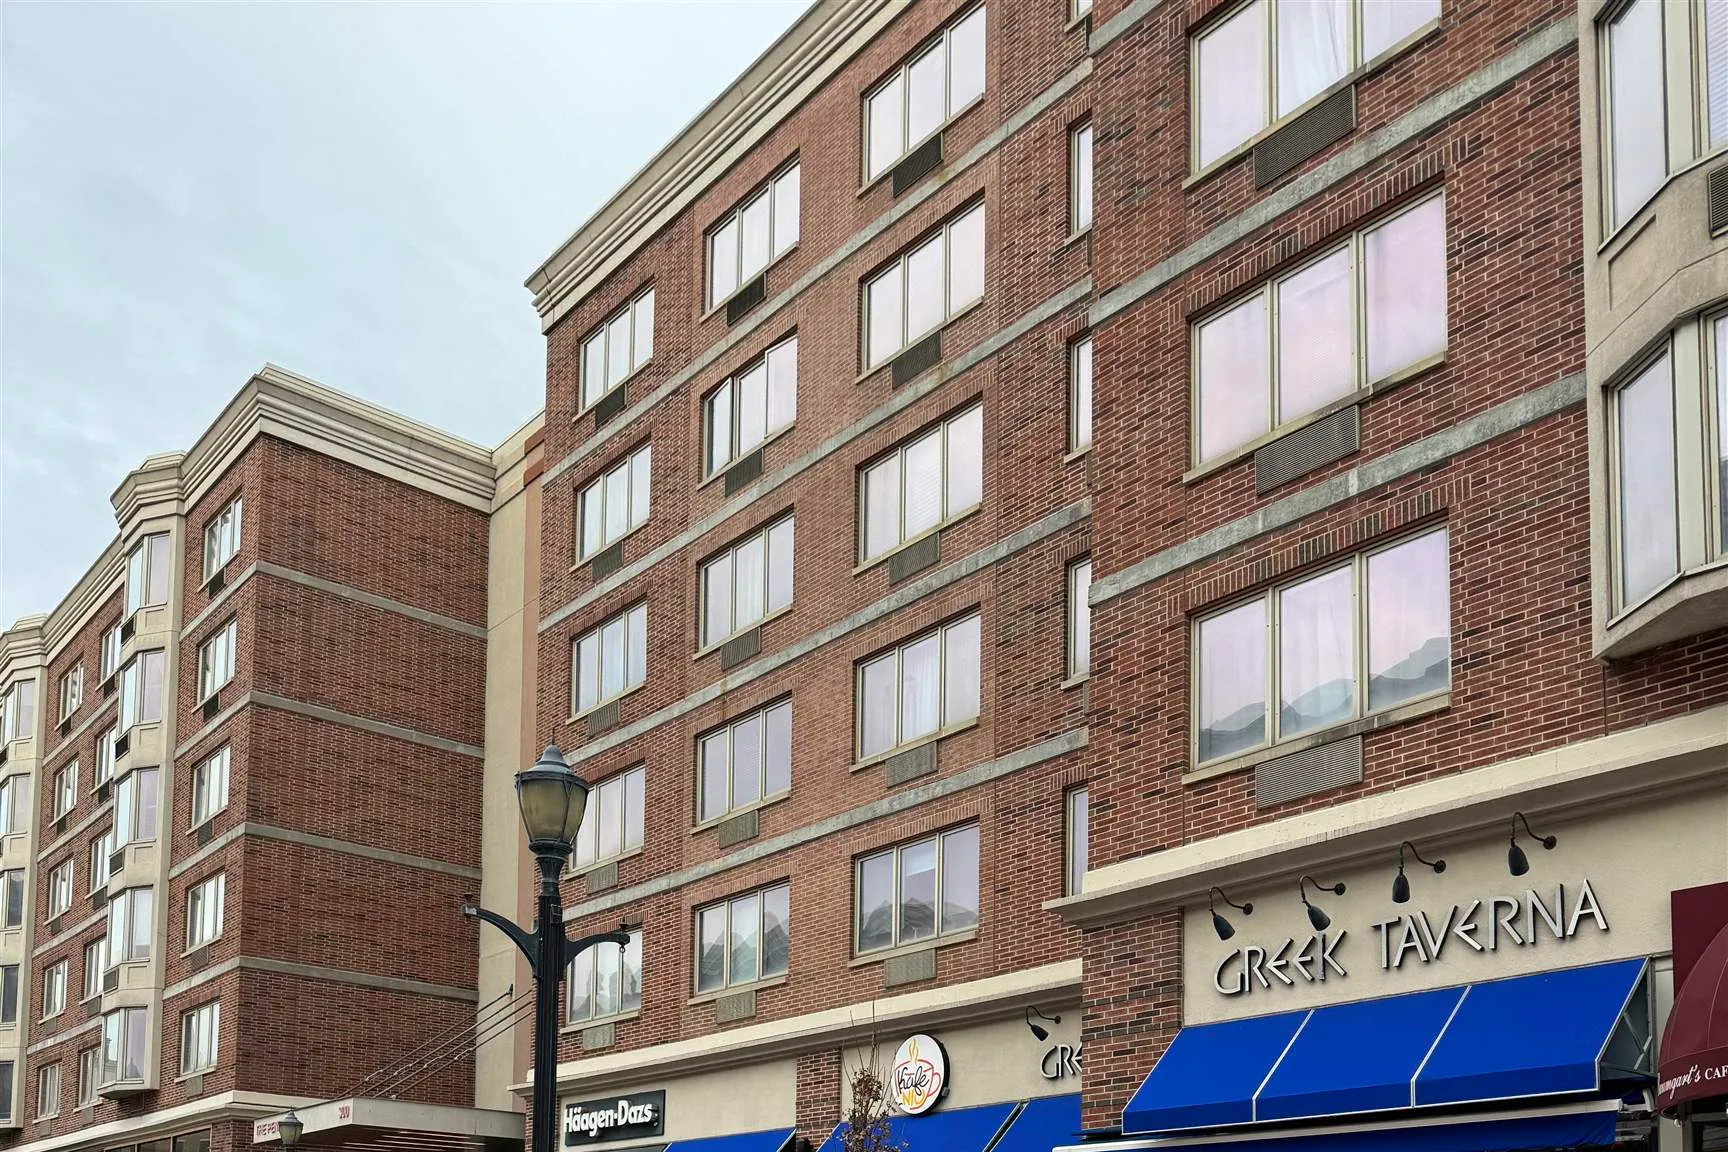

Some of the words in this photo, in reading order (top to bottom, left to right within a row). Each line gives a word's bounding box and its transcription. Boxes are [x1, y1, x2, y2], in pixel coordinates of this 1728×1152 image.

[1214, 929, 1347, 996] GREEK
[1370, 878, 1609, 969] TAVERNA
[1040, 1042, 1082, 1080] GRE
[1704, 1064, 1728, 1081] CAF
[563, 1100, 653, 1137] Häagen-Dazs
